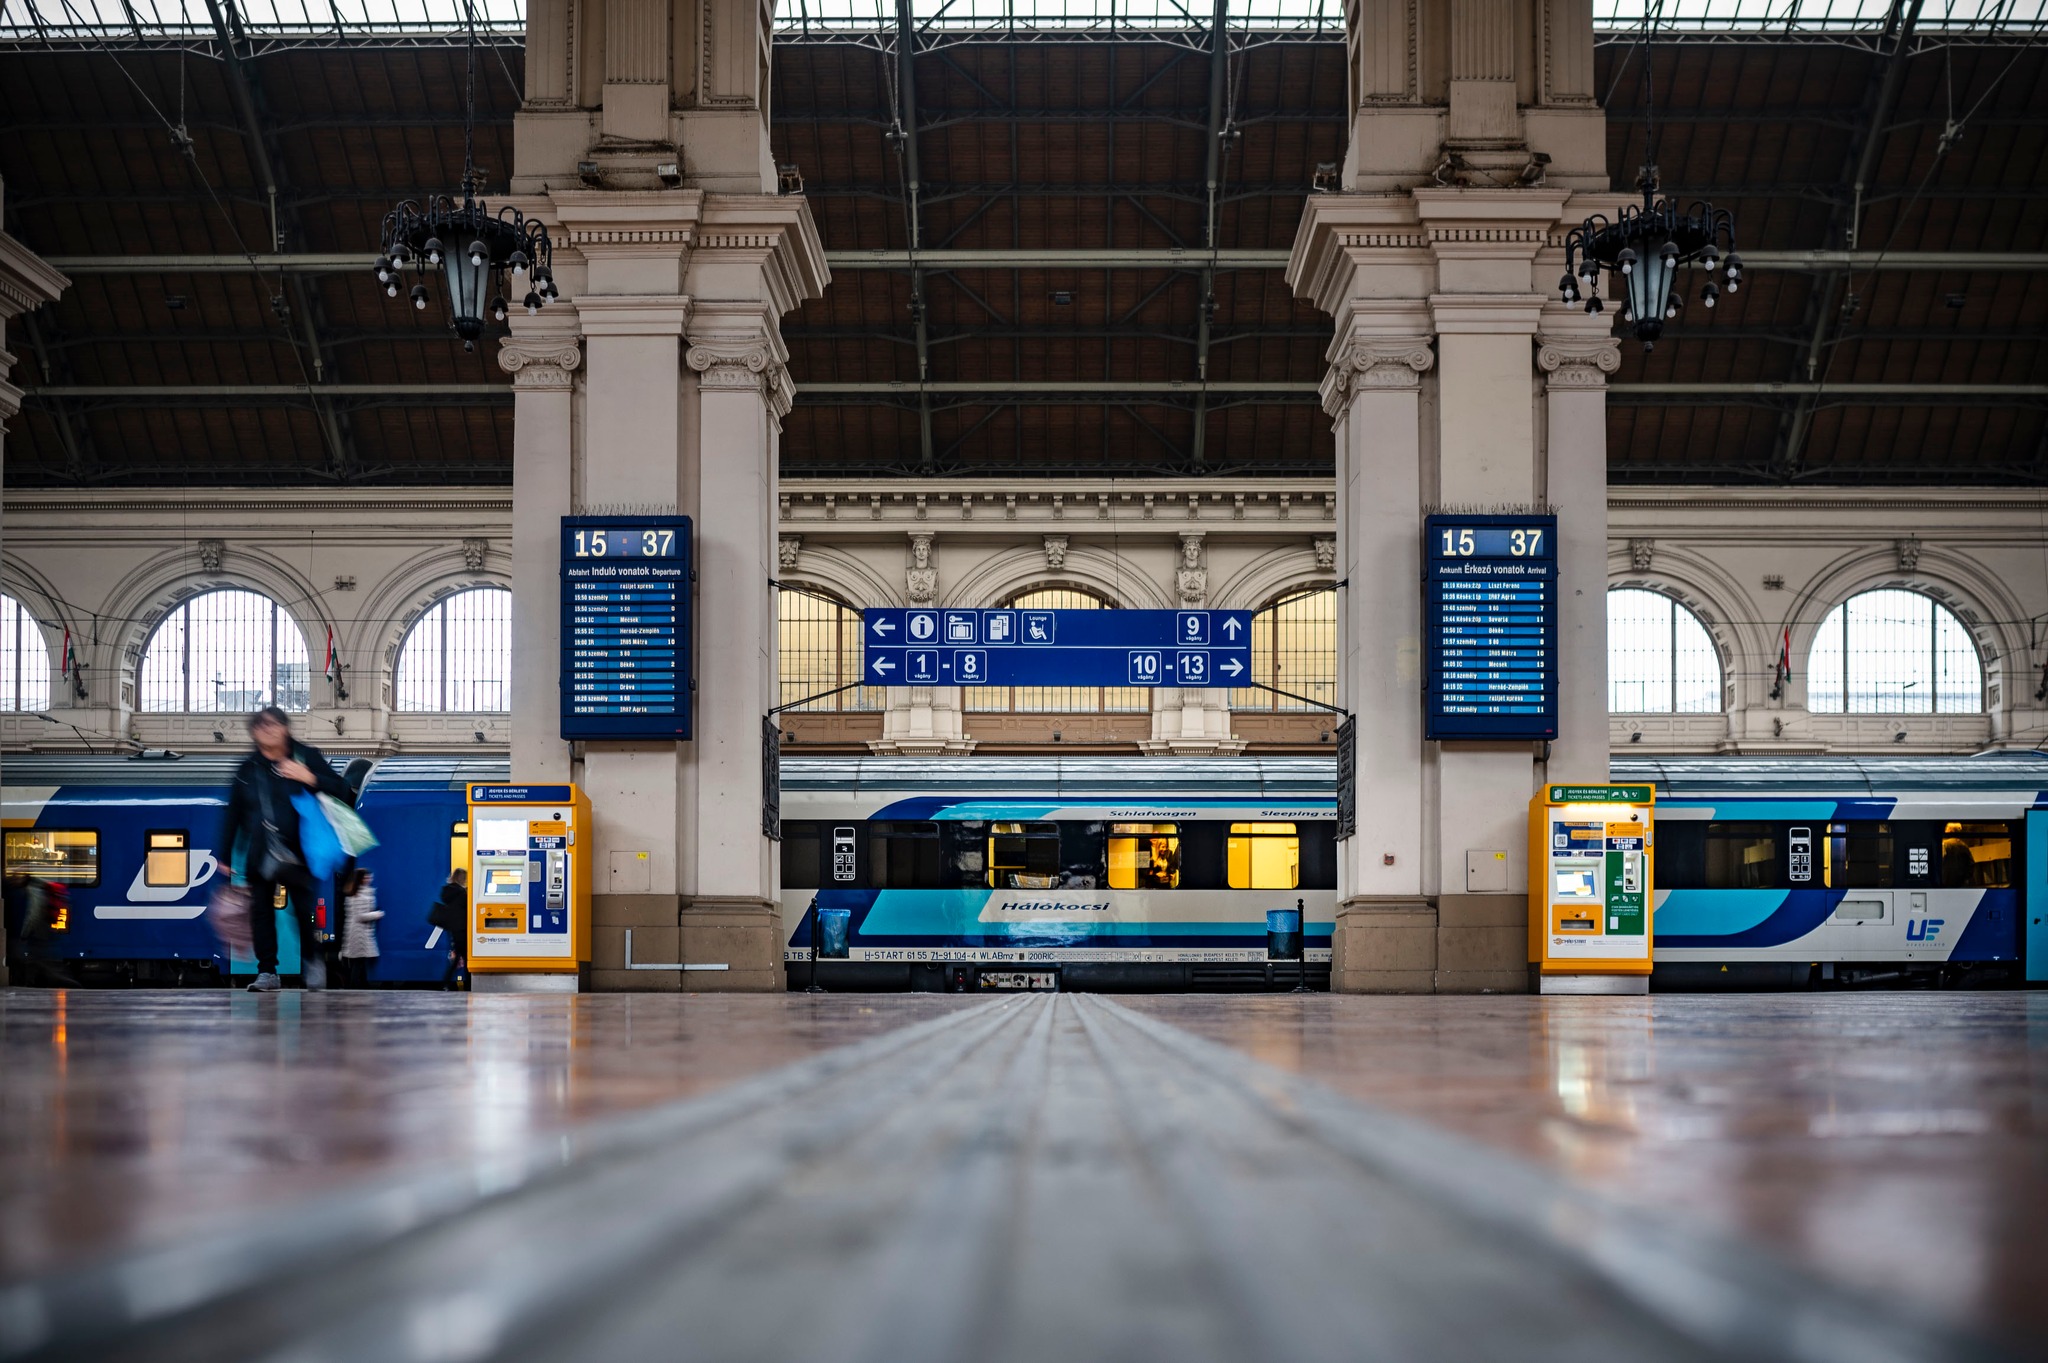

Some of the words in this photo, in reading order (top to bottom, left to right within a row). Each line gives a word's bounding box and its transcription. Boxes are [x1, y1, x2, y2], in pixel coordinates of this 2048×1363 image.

[576, 531, 606, 557] 15
[642, 531, 674, 557] 37
[1443, 529, 1474, 556] 15
[1510, 529, 1542, 556] 37
[568, 568, 590, 577] Abfahrt
[592, 566, 616, 577] Induló
[618, 566, 650, 576] vonatok
[652, 569, 681, 578] Departure
[1440, 566, 1462, 574] Ankunft
[1465, 563, 1491, 574] Érkező
[1493, 564, 1525, 574] vonatok
[1187, 617, 1199, 635] 9
[916, 655, 926, 672] 1
[964, 655, 976, 672] 8
[1133, 656, 1157, 674] 10
[1180, 656, 1204, 674] 13
[1001, 903, 1110, 911] Hálókocsi
[865, 952, 904, 960] H-START
[931, 952, 951, 960] 71-91
[954, 952, 976, 960] 104-4
